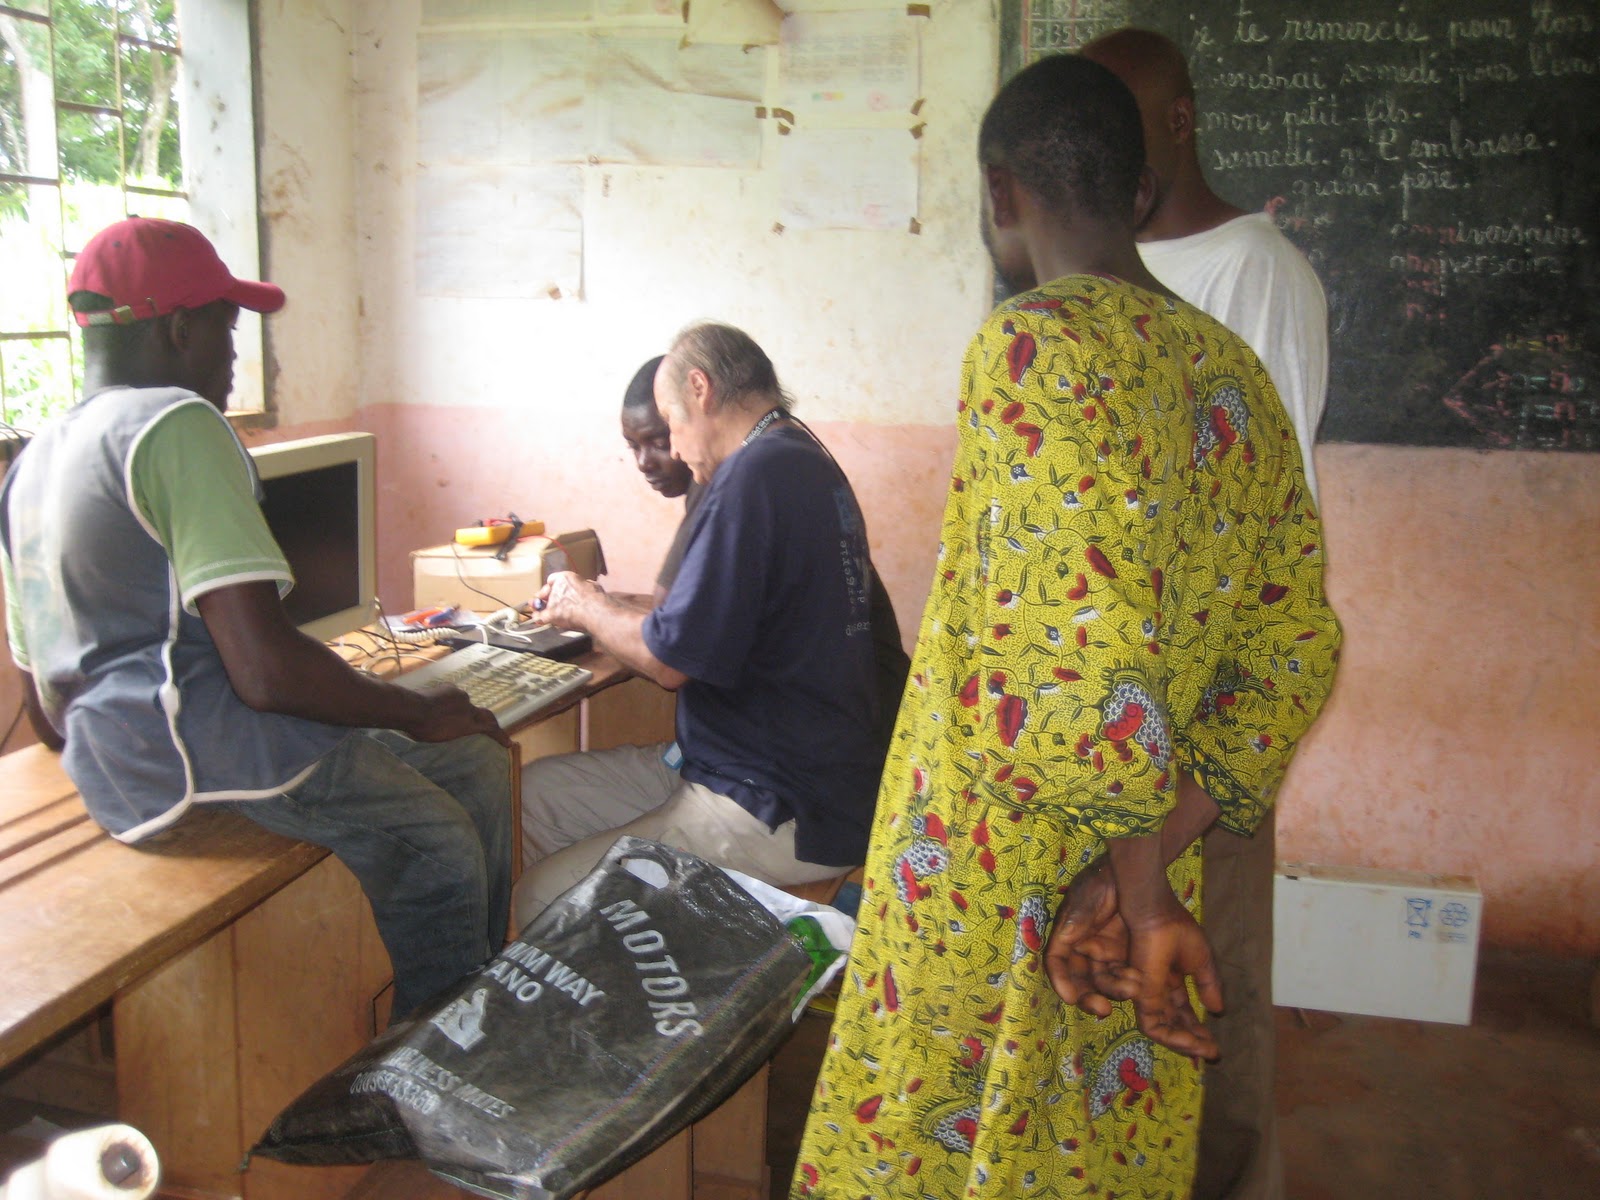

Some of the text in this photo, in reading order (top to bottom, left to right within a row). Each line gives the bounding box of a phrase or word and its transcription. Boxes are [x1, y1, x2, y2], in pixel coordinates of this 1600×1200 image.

[1234, 0, 1270, 42] te
[1201, 110, 1272, 134] mon
[543, 959, 606, 1007] WAY
[599, 899, 704, 1037] MOTORS
